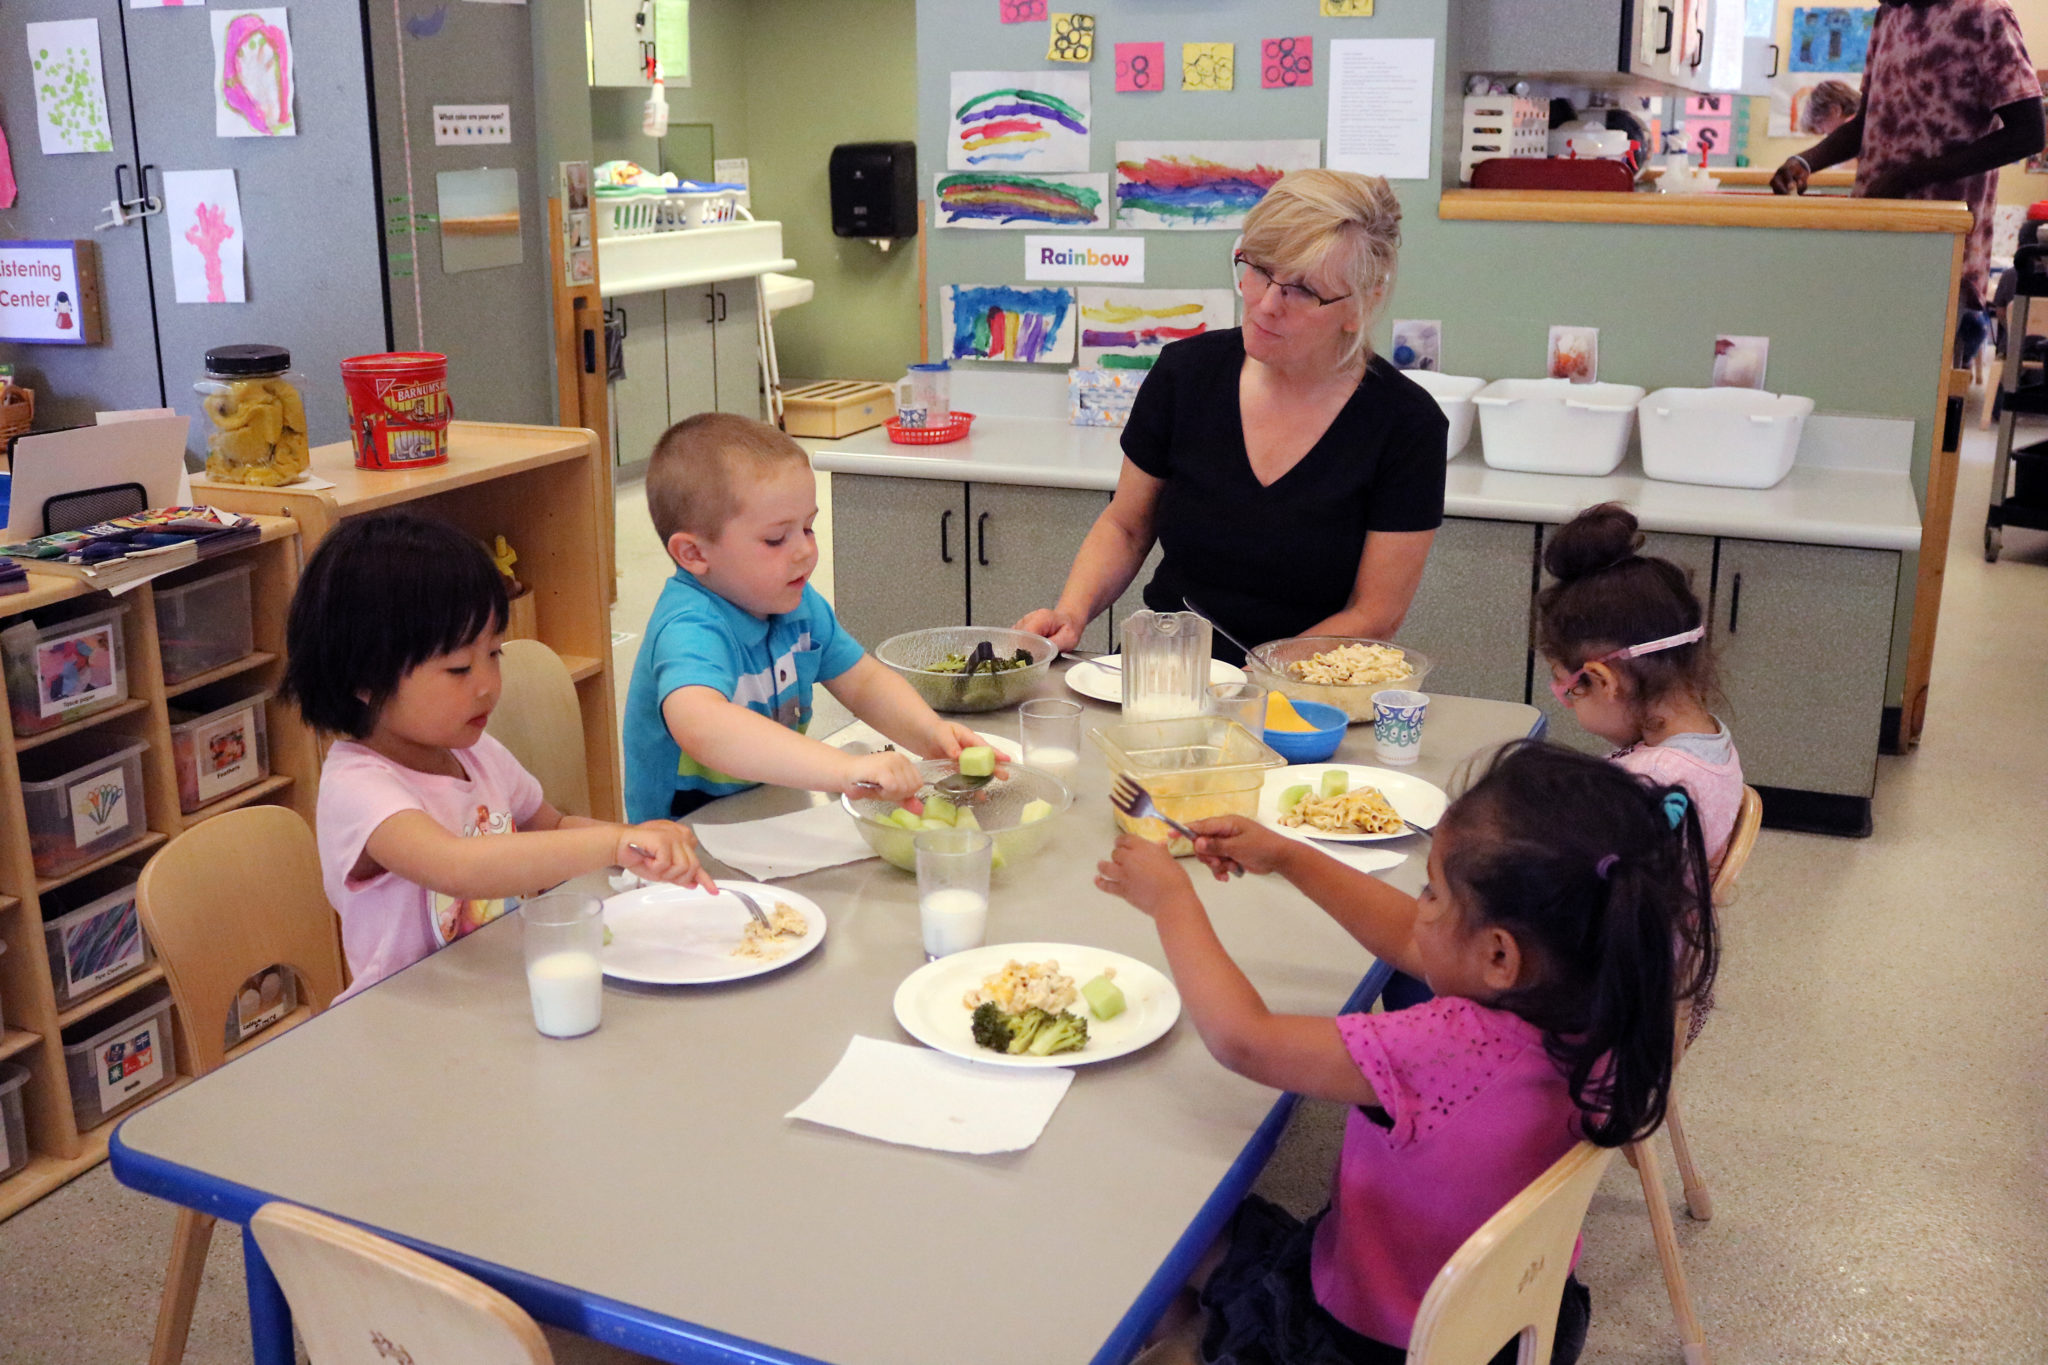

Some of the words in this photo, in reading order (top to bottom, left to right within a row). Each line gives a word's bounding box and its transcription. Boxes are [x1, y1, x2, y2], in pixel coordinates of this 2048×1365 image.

[1697, 128, 1718, 149] S
[1041, 247, 1129, 266] Rainbow
[0, 291, 50, 307] Center
[397, 382, 440, 402] BARNUM'S
[217, 765, 240, 779] Feathers
